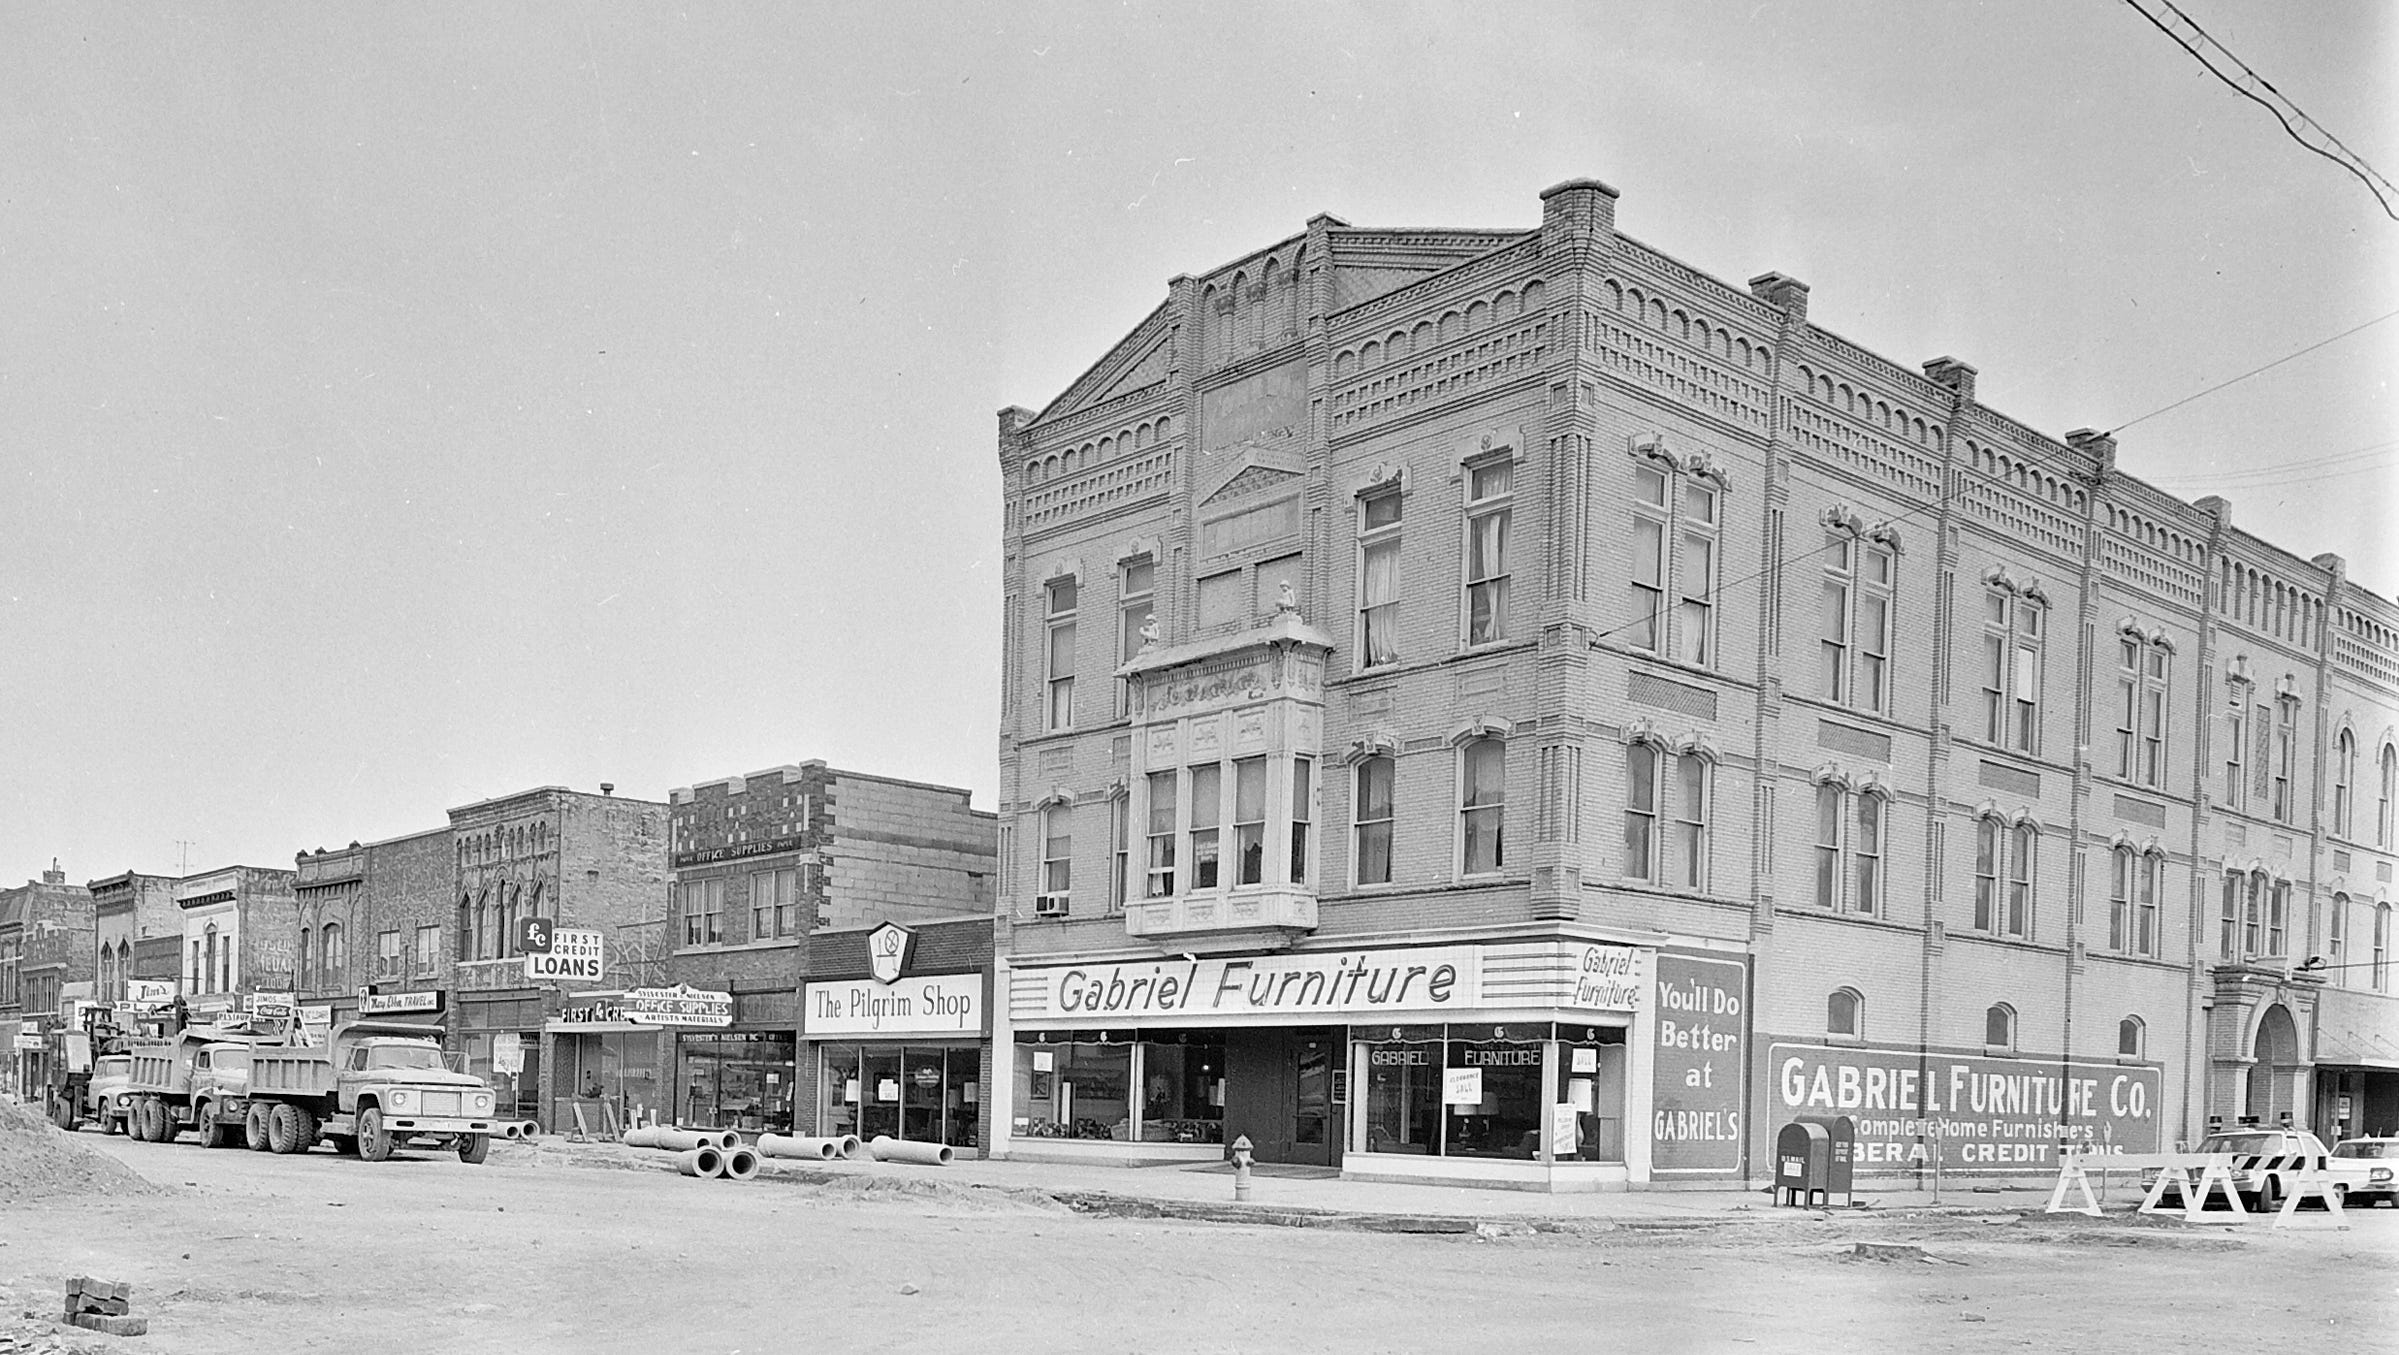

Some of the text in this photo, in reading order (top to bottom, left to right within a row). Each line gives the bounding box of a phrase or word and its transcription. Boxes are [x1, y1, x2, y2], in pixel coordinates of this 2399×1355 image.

[696, 850, 725, 862] OFFICE
[731, 841, 773, 857] SUPPLIES
[554, 933, 599, 945] FIRST
[554, 944, 600, 956] CREDIT
[534, 956, 599, 977] LOANS
[1583, 946, 1634, 978] Gabriel
[1059, 955, 1457, 1012] Gabriel Furniture
[1573, 975, 1636, 1009] Furniture
[404, 995, 427, 1007] TRAVEL
[638, 990, 678, 999] SYLVESTER
[1658, 977, 1740, 1016] You'll Do
[562, 1007, 591, 1023] FIRST
[636, 1000, 729, 1015] OFFICE SUPPLIES
[815, 984, 971, 1030] The Pilgrim Shop
[682, 1016, 724, 1024] MATERIALS
[1494, 1026, 1504, 1038] G
[1660, 1020, 1738, 1051] Better
[1371, 1049, 1541, 1066] GABRIEL FURNITURE
[1685, 1060, 1712, 1088] at
[1781, 1056, 1941, 1112] GABRIEL
[1950, 1064, 2098, 1117] FURNITURE
[1654, 1107, 1738, 1140] GABRIEL'S
[1940, 1116, 1988, 1137] Home
[1853, 1142, 1943, 1162] BERAL
[1961, 1143, 2049, 1162] CREDIT
